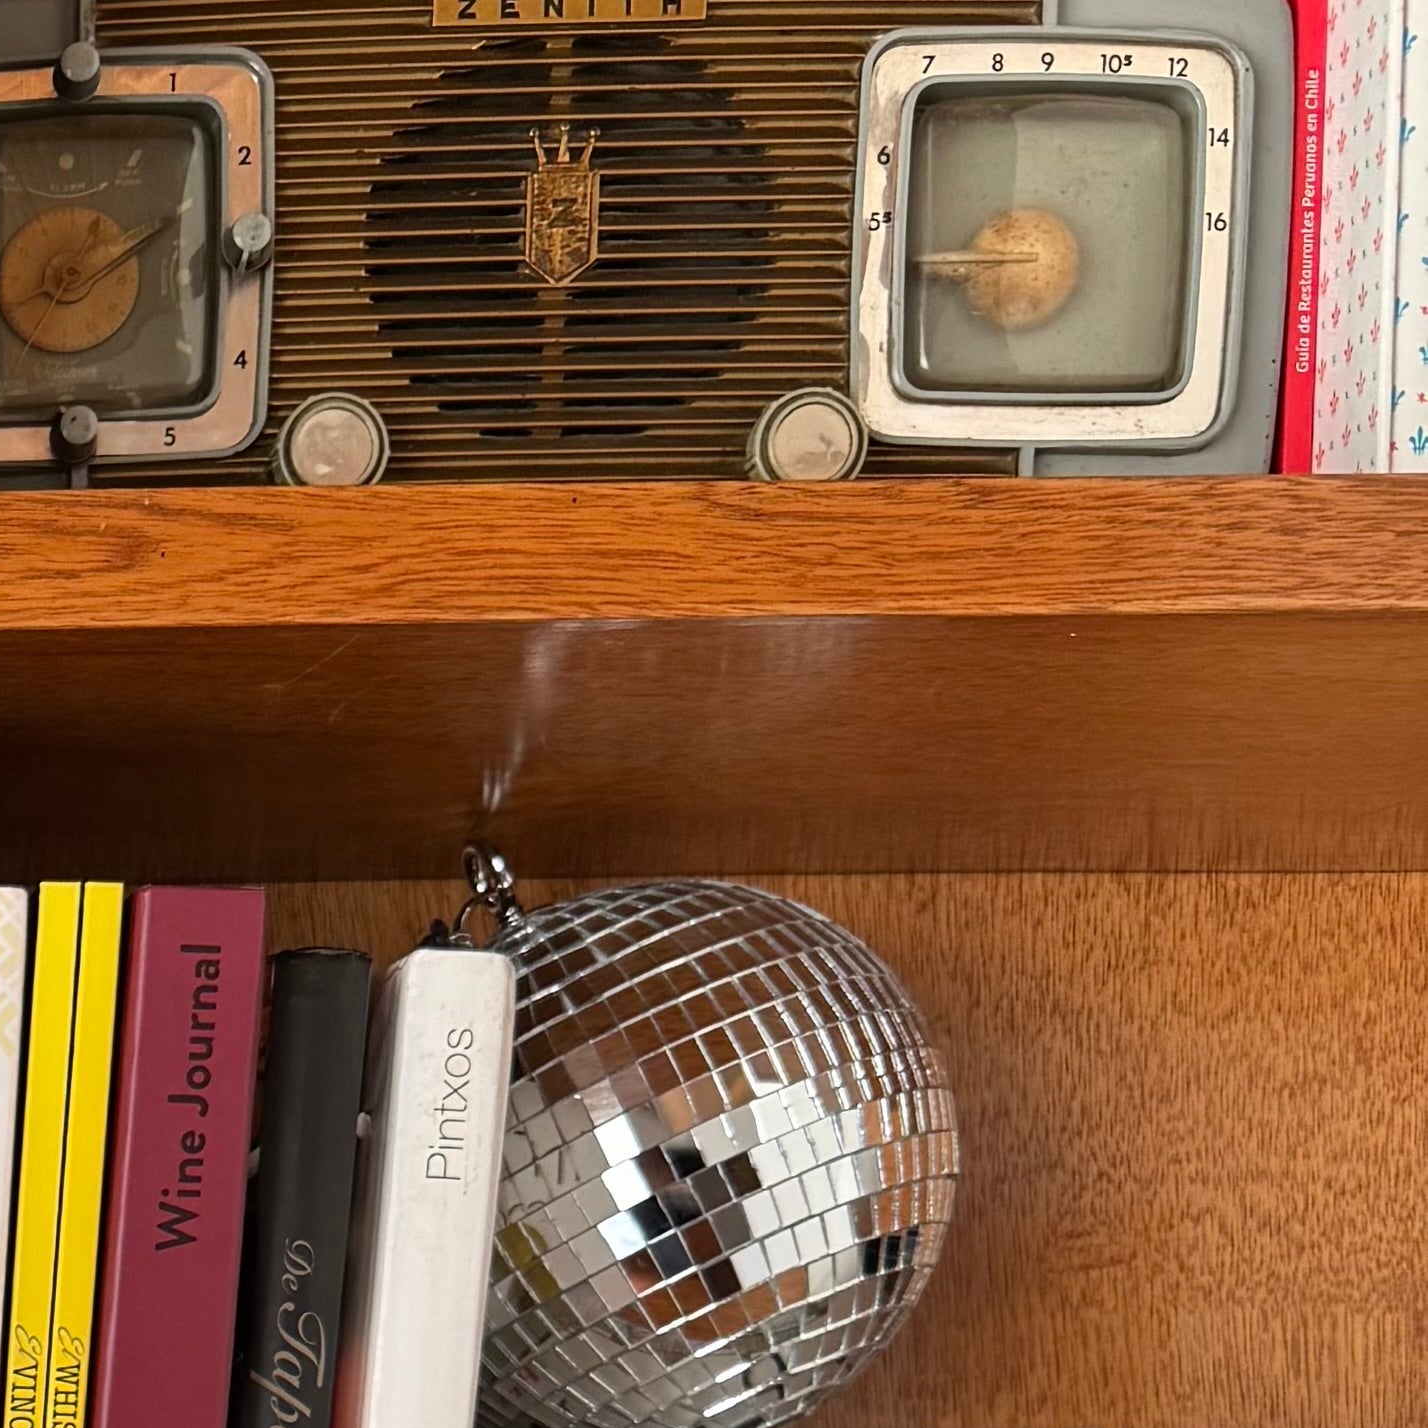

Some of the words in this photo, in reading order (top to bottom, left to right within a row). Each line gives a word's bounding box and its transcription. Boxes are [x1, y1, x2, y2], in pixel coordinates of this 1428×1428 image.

[921, 55, 936, 75] 7
[992, 54, 1004, 72] 8
[1041, 52, 1055, 72] 9
[1167, 57, 1189, 78] 12
[1304, 69, 1319, 111] Chile
[1306, 113, 1318, 132] en
[1208, 127, 1231, 148] 14
[237, 146, 252, 166] 2
[876, 145, 891, 166] 6
[1301, 134, 1318, 209] Peruanos
[1205, 212, 1227, 232] 16
[1297, 210, 1315, 315] Restaurantes
[1297, 316, 1310, 335] de
[233, 350, 248, 371] 4
[162, 427, 176, 447] 5
[167, 943, 222, 1117] Journal
[426, 1028, 474, 1181] Pintxos
[154, 1131, 209, 1252] Wine
